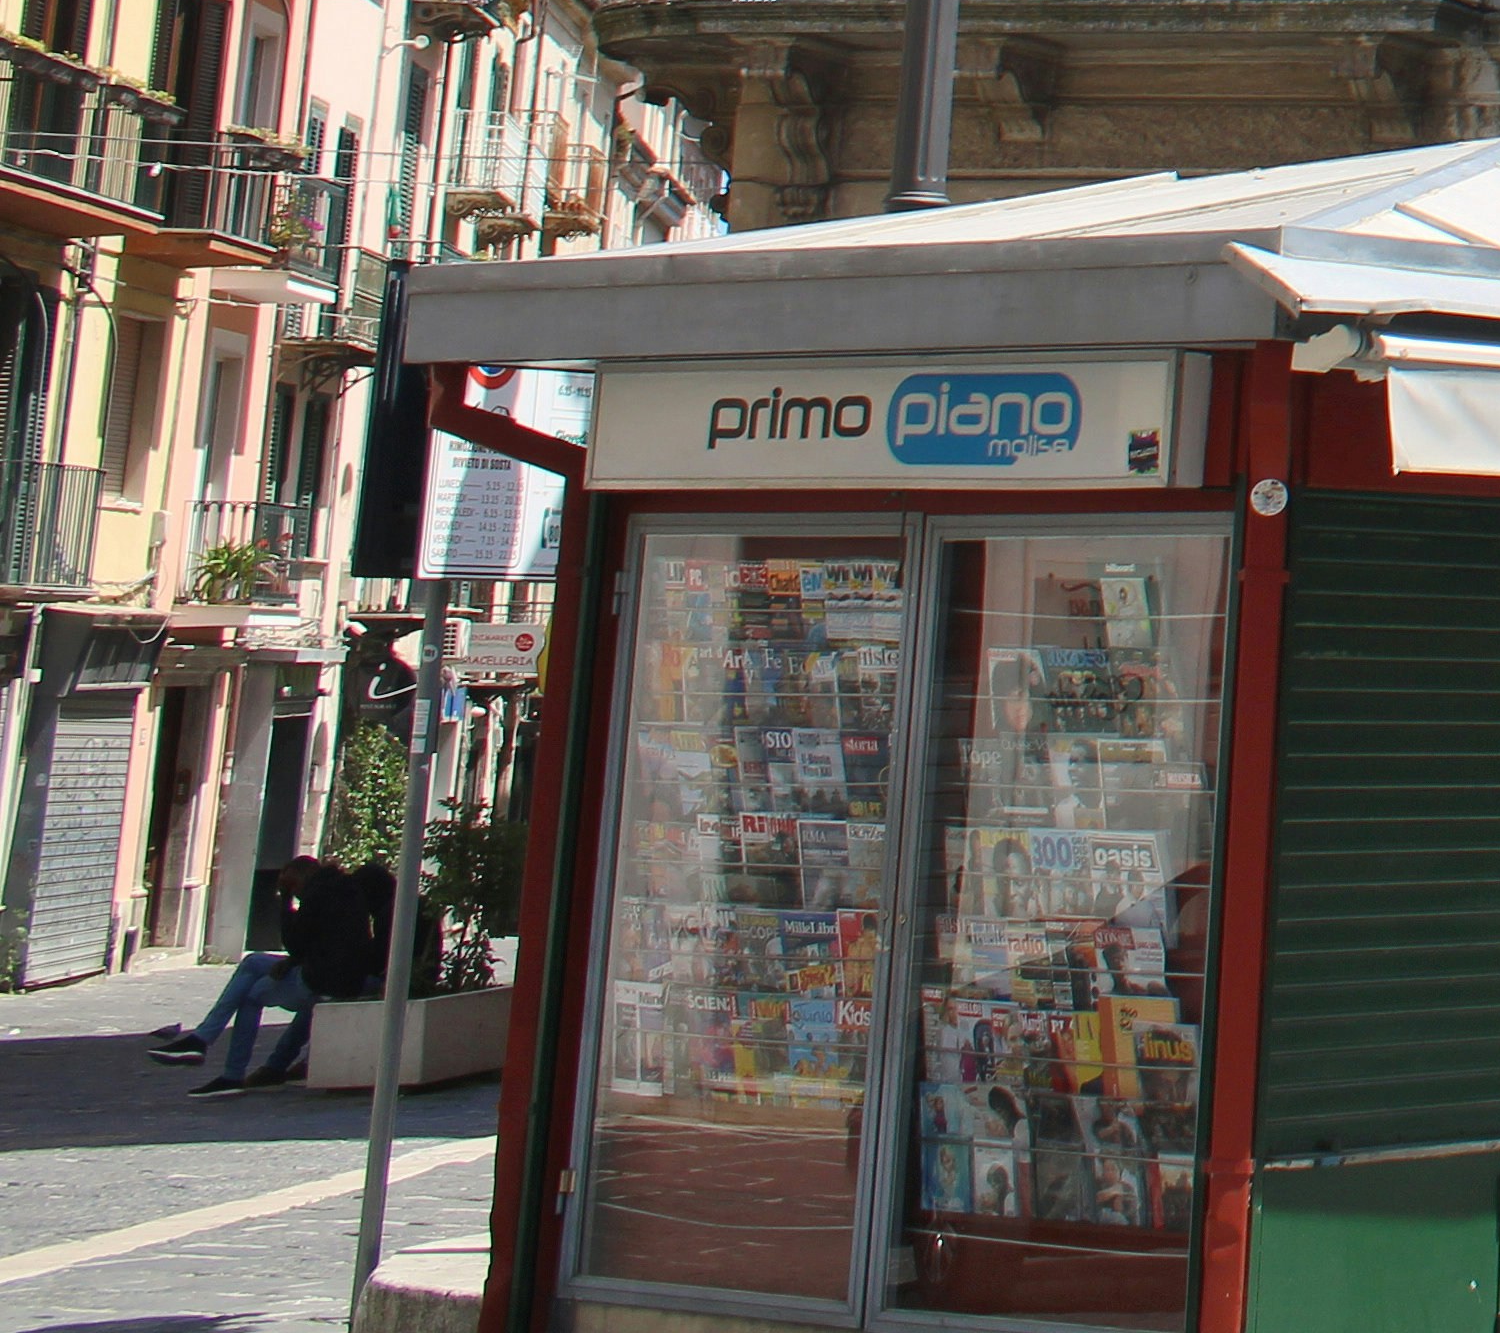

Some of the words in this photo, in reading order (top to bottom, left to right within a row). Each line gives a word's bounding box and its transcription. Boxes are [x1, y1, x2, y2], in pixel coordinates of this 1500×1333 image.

[707, 386, 873, 450] primo
[895, 380, 1073, 446] piano
[987, 436, 1074, 457] molise
[1032, 835, 1074, 867] 300
[1095, 844, 1153, 868] oasis
[838, 1000, 872, 1027] Kids
[1143, 1031, 1195, 1062] linus
